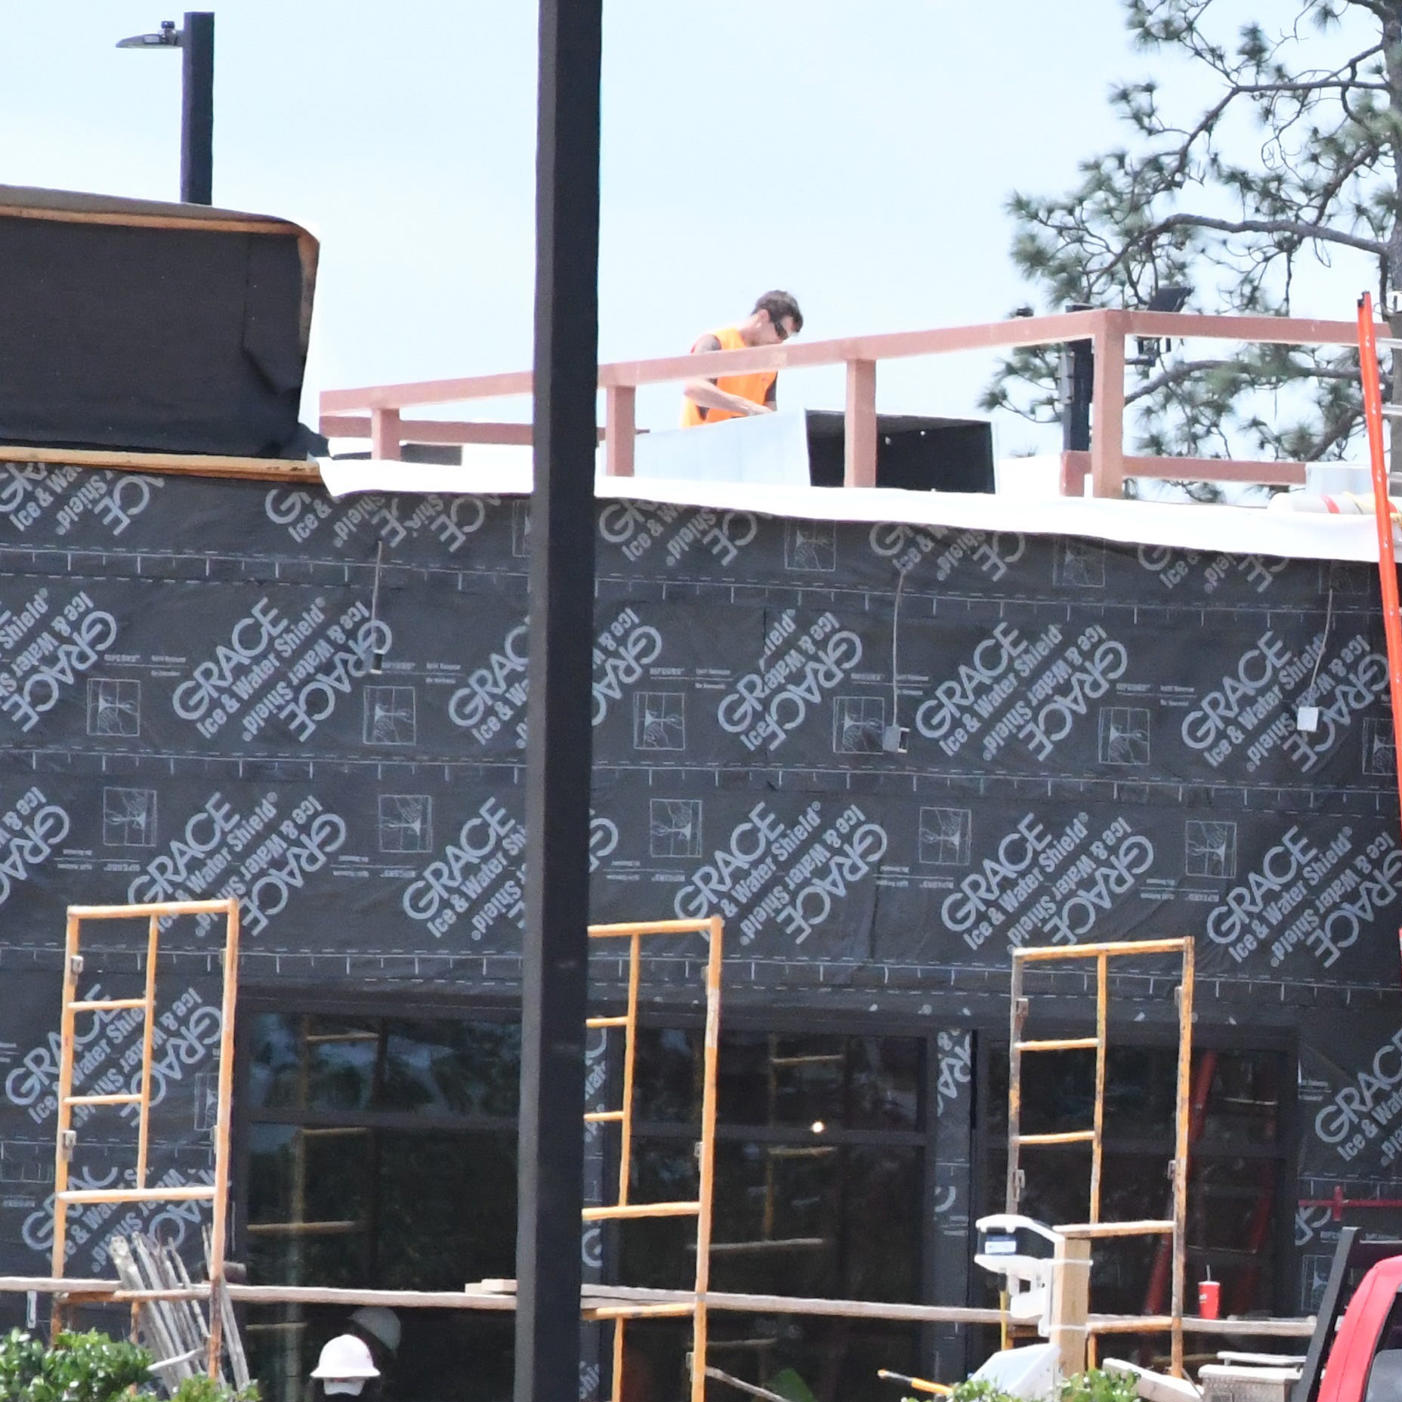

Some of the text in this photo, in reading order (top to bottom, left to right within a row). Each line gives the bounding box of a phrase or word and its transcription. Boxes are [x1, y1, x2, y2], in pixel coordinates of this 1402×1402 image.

[9, 506, 41, 532] Ice
[288, 516, 318, 543] Ice
[63, 591, 94, 622] Ice
[340, 600, 370, 631] Ice
[809, 612, 841, 642] Ice
[172, 597, 288, 721] GRACE
[288, 637, 335, 686] Water
[1077, 624, 1108, 652] Ice
[1, 610, 117, 733] GRACE
[196, 713, 228, 739] Ice
[232, 652, 281, 700] Water
[278, 620, 393, 741] GRACE
[449, 625, 528, 727] GRAC
[915, 622, 1028, 739] GRACE
[1032, 660, 1073, 707] Water
[1181, 631, 1292, 750] GRACE
[940, 730, 967, 757] Ice
[973, 671, 1019, 720] Water
[1018, 640, 1128, 762] GRACE
[471, 717, 502, 746] Ice
[1204, 743, 1231, 768] Ice
[1238, 685, 1284, 731] Water
[16, 786, 47, 815] Ice
[292, 795, 323, 824] Ice
[836, 804, 867, 833] Ice
[1102, 816, 1132, 846] Ice
[1366, 832, 1395, 861] Ice
[186, 848, 233, 893] Water
[240, 835, 288, 882] Water
[242, 813, 346, 937] GRACE
[402, 797, 516, 920] GRACE
[674, 801, 784, 921] GRACE
[732, 857, 777, 904] Water
[785, 844, 831, 890] Water
[941, 812, 1052, 932] GRACE
[1051, 855, 1097, 901] Water
[427, 913, 457, 938] Ice
[460, 852, 508, 900] Water
[776, 823, 887, 945] GRACE
[963, 927, 992, 951] Ice
[998, 864, 1043, 913] Water
[1043, 835, 1154, 946] GRACE
[1206, 825, 1318, 945] GRACE
[1319, 868, 1361, 915] Water
[1228, 941, 1258, 963] Ice
[1262, 879, 1308, 925] Water
[172, 987, 202, 1016] Ice
[1336, 1134, 1366, 1161] Ice
